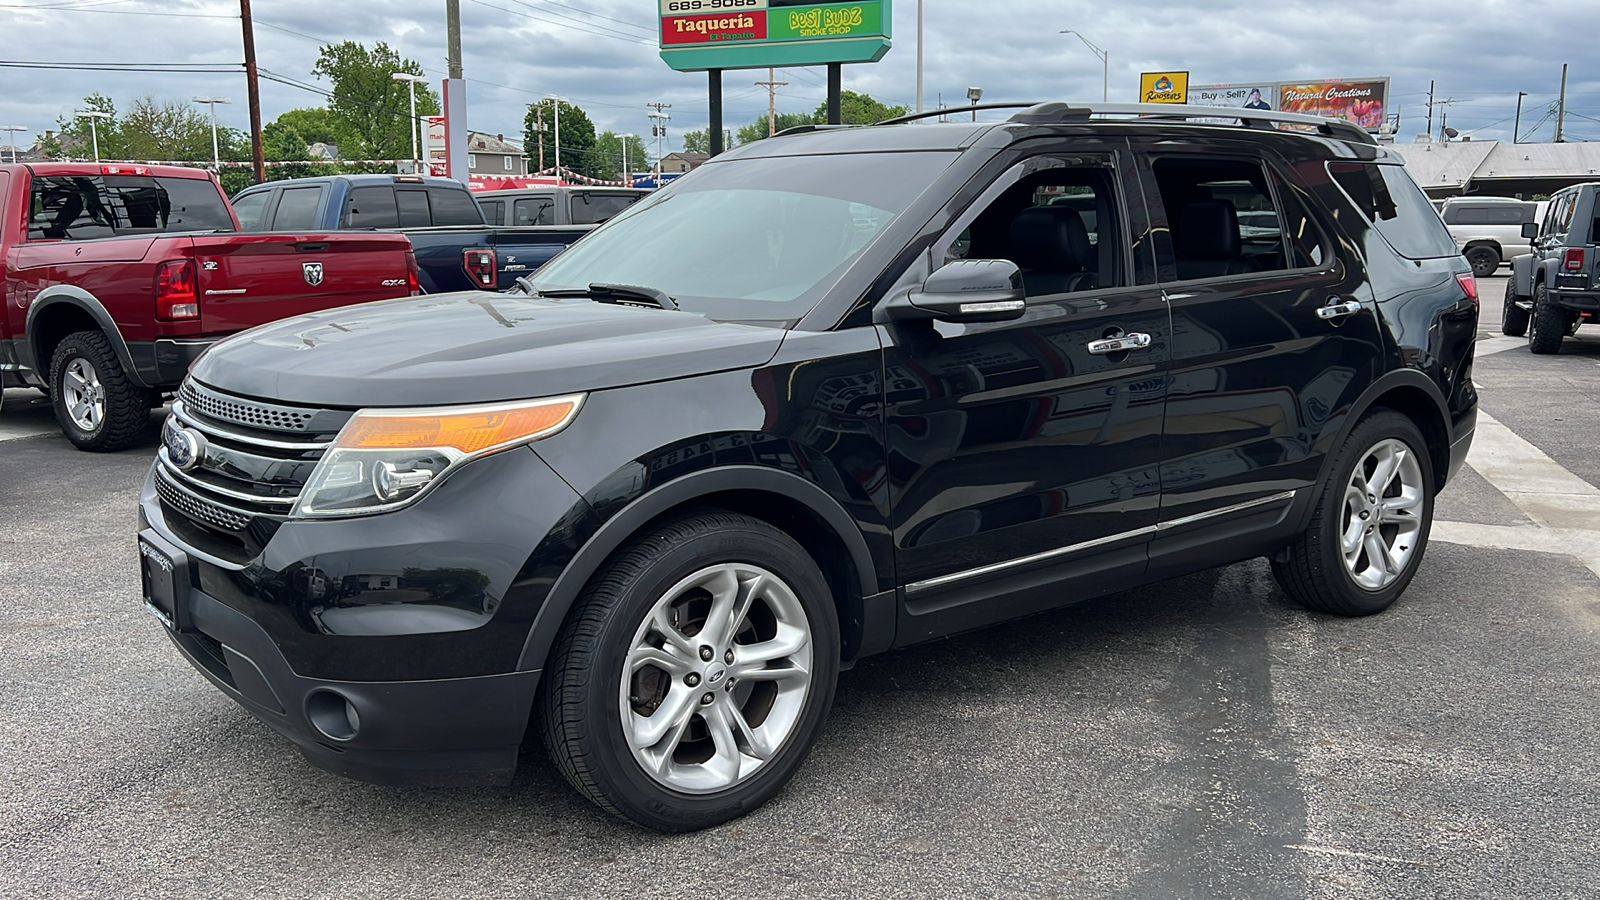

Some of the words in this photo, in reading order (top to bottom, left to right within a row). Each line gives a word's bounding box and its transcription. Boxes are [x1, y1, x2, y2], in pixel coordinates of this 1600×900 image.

[800, 28, 827, 37] SMOKE
[828, 26, 851, 35] SHOP
[1145, 91, 1182, 102] Roosters
[1201, 92, 1217, 100] Buy
[1226, 90, 1246, 99] Sell?
[1285, 89, 1325, 101] Natural
[1325, 87, 1372, 100] Creations
